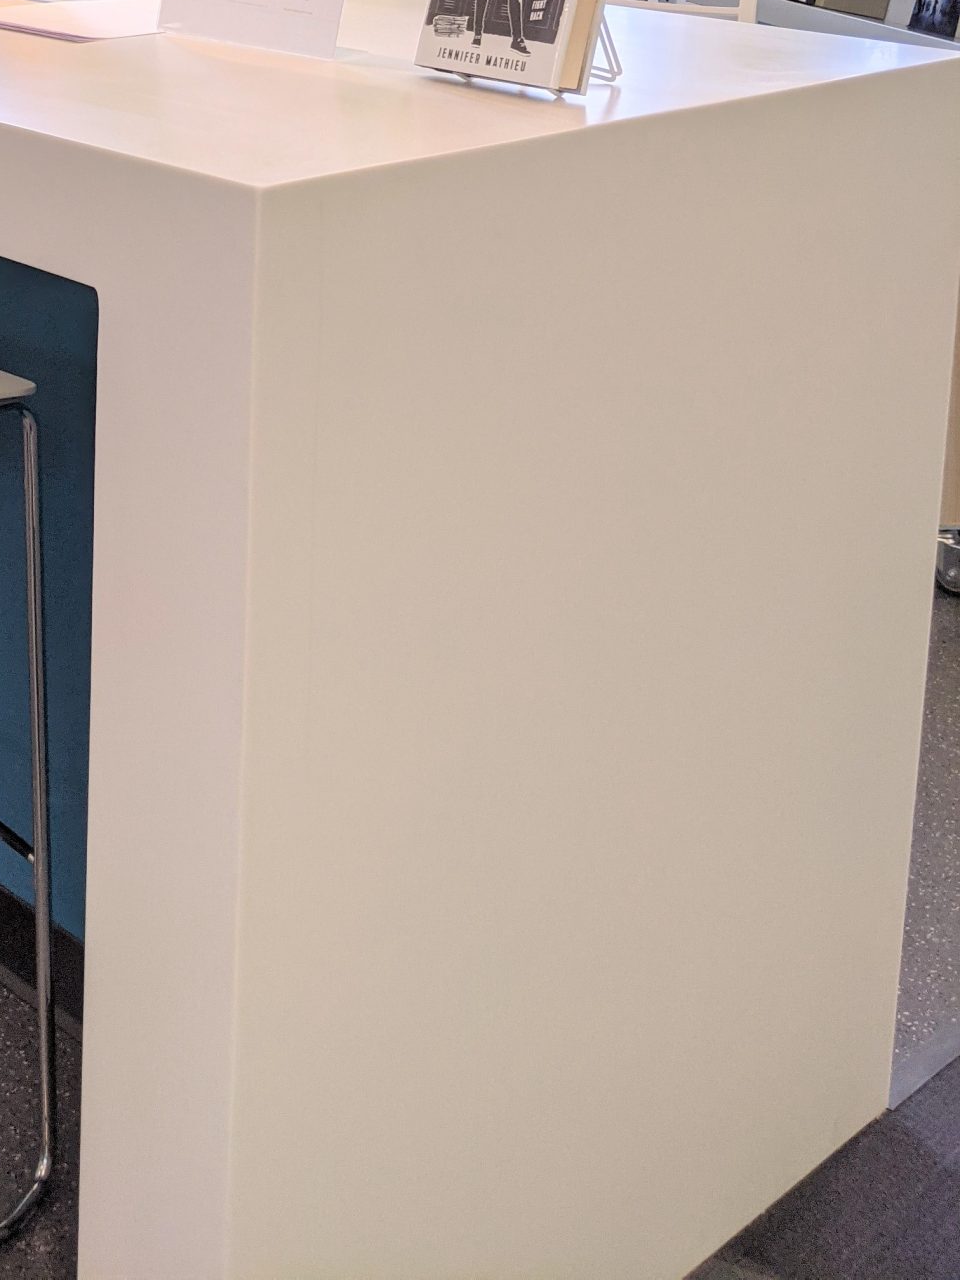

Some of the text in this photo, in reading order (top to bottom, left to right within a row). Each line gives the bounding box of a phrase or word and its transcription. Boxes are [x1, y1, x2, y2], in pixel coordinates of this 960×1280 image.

[532, 0, 547, 10] FIGHT
[529, 11, 544, 21] BACK
[437, 47, 527, 72] JENNIFER MATHIEU
